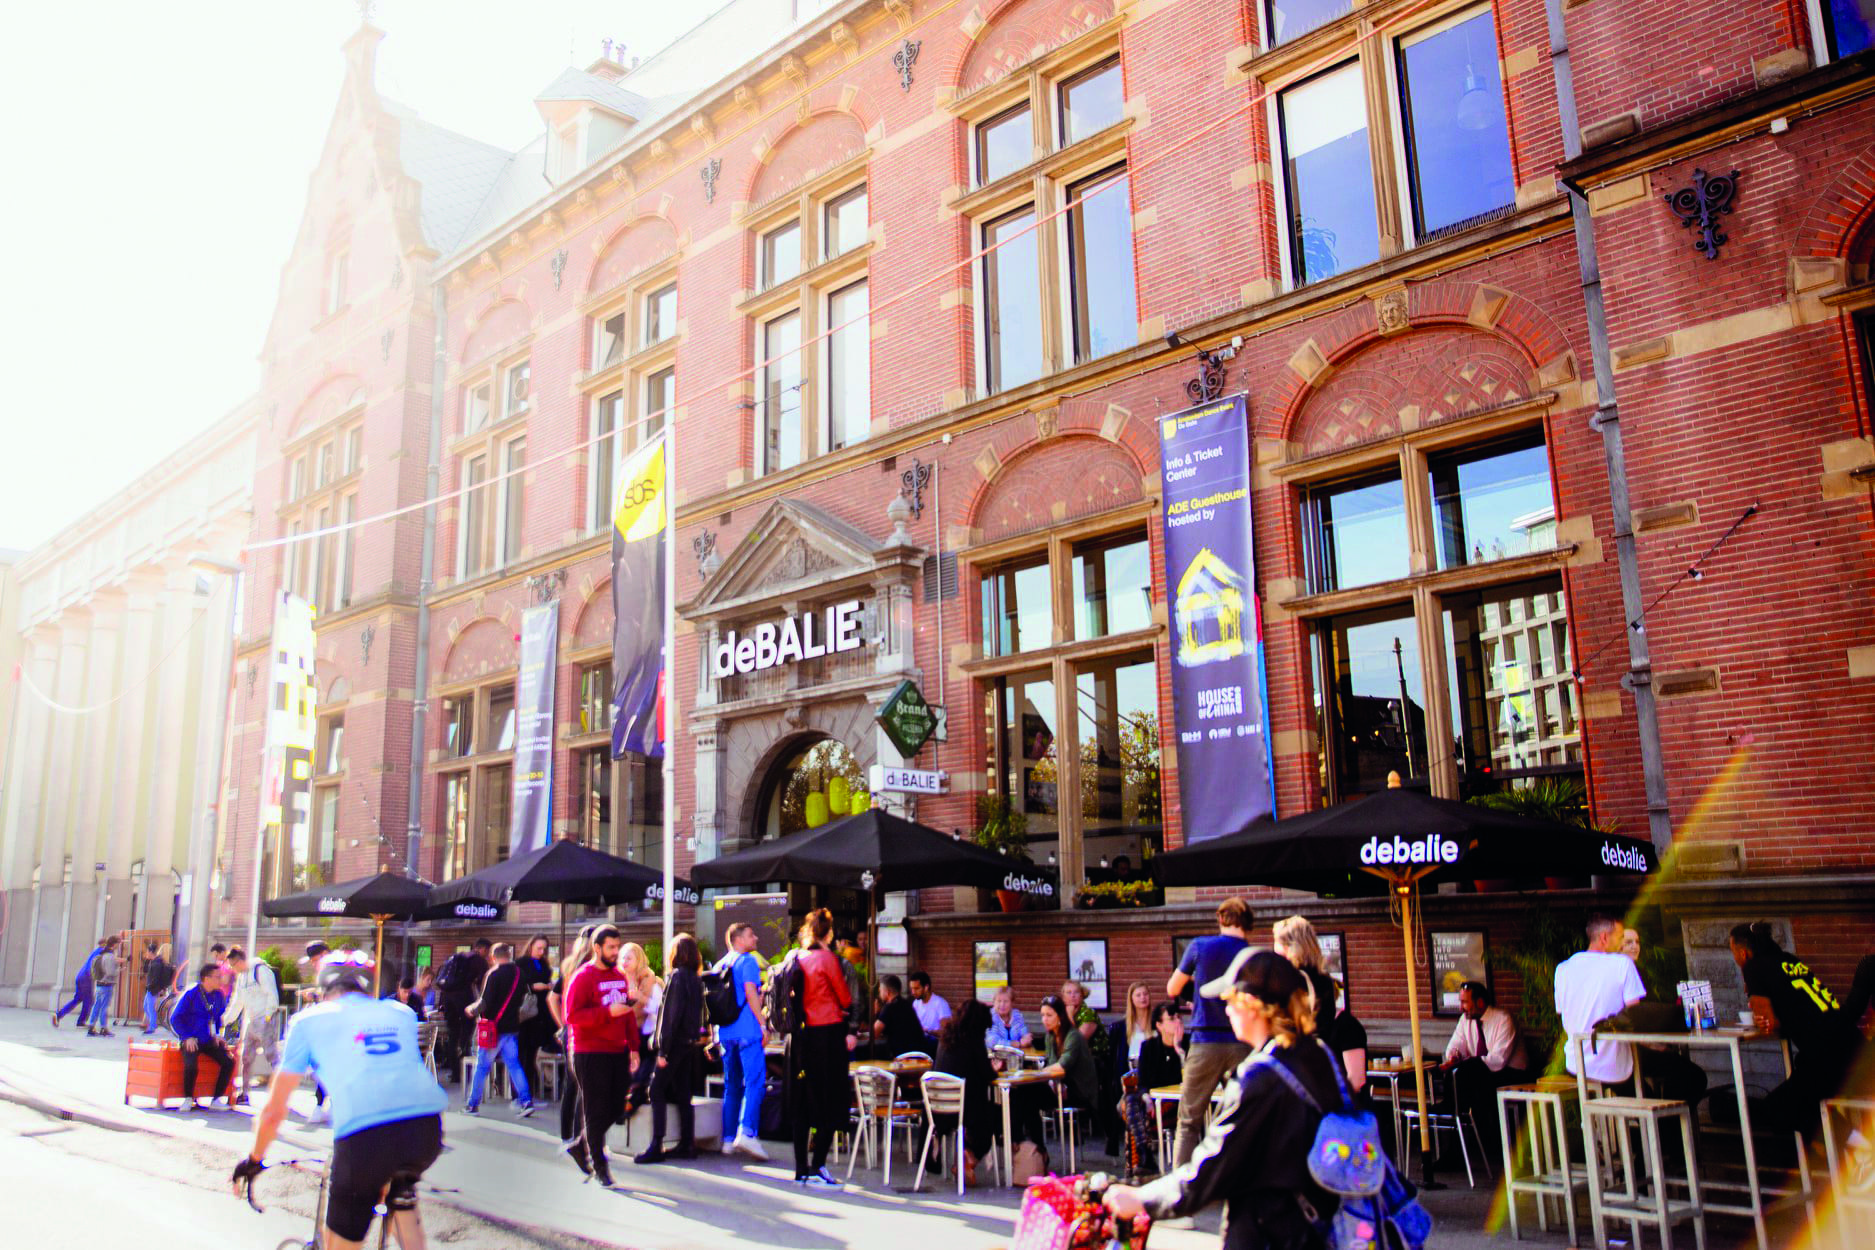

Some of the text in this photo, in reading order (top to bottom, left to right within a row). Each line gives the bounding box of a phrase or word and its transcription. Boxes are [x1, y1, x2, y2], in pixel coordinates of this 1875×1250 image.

[1166, 446, 1223, 470] Info & Ticket
[1166, 467, 1197, 482] Center
[1168, 488, 1247, 515] ADE Guesthouse
[1168, 509, 1215, 527] hosted by
[714, 600, 861, 679] deBALIE
[1198, 686, 1235, 707] HOUSE
[896, 700, 927, 717] Brand
[887, 771, 936, 789] dBALIE
[1360, 834, 1459, 864] debalie
[1601, 840, 1647, 872] debalie
[646, 883, 699, 903] dealie
[1003, 871, 1053, 897] debalie
[319, 898, 347, 912] debalie
[456, 903, 498, 917] debalie
[365, 1033, 401, 1055] 5
